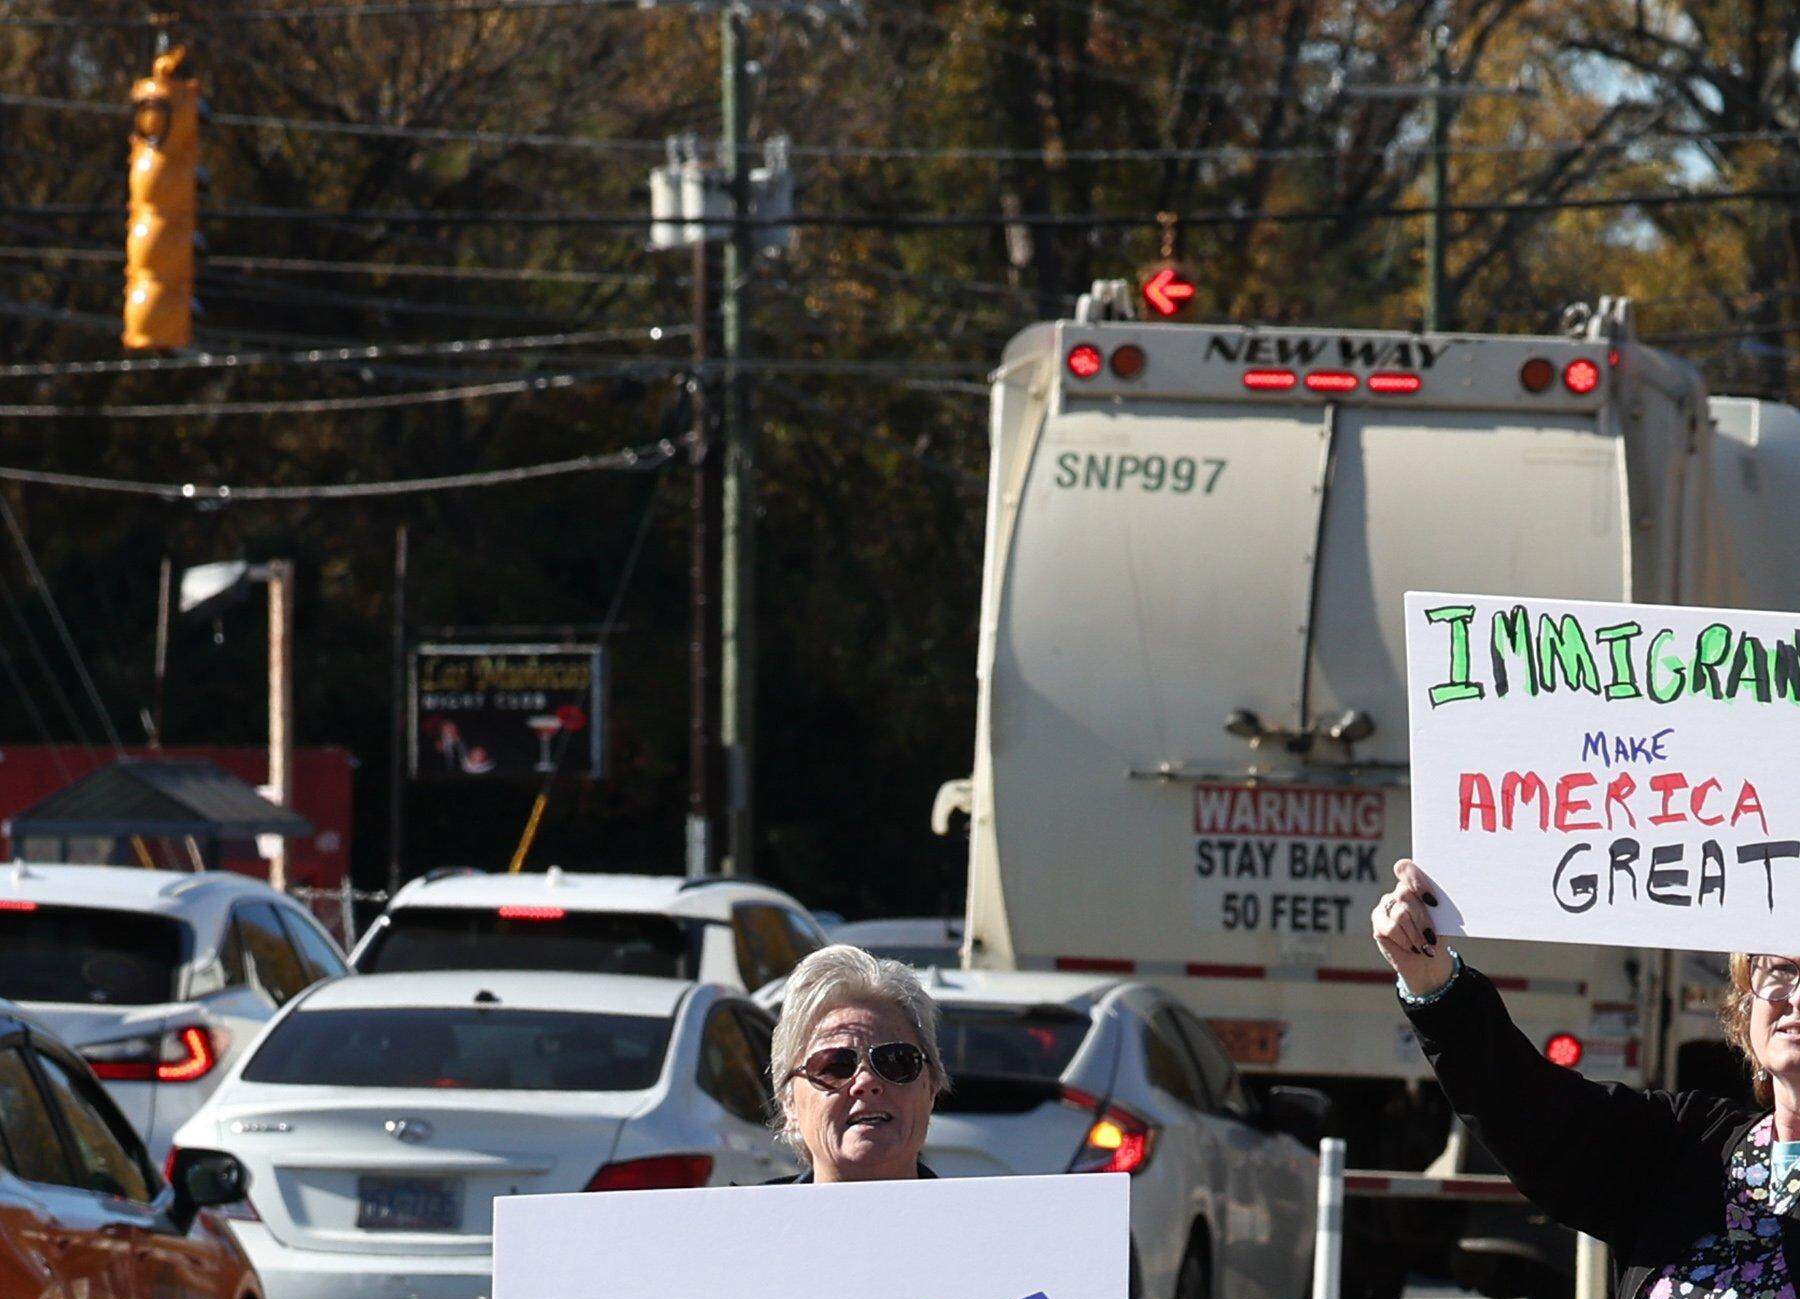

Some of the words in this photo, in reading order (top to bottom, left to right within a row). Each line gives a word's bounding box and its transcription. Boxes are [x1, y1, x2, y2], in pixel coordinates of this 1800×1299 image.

[1203, 334, 1328, 364] NEW
[1337, 337, 1448, 369] WAY
[1055, 452, 1227, 494] SNP997
[1582, 728, 1675, 767] MAKE
[1199, 790, 1384, 834] WARNING
[1459, 771, 1770, 836] AMERICA
[1196, 839, 1278, 878] STAY
[1289, 843, 1379, 882] BACK
[1222, 893, 1260, 931] 50
[1271, 895, 1354, 933] FEET
